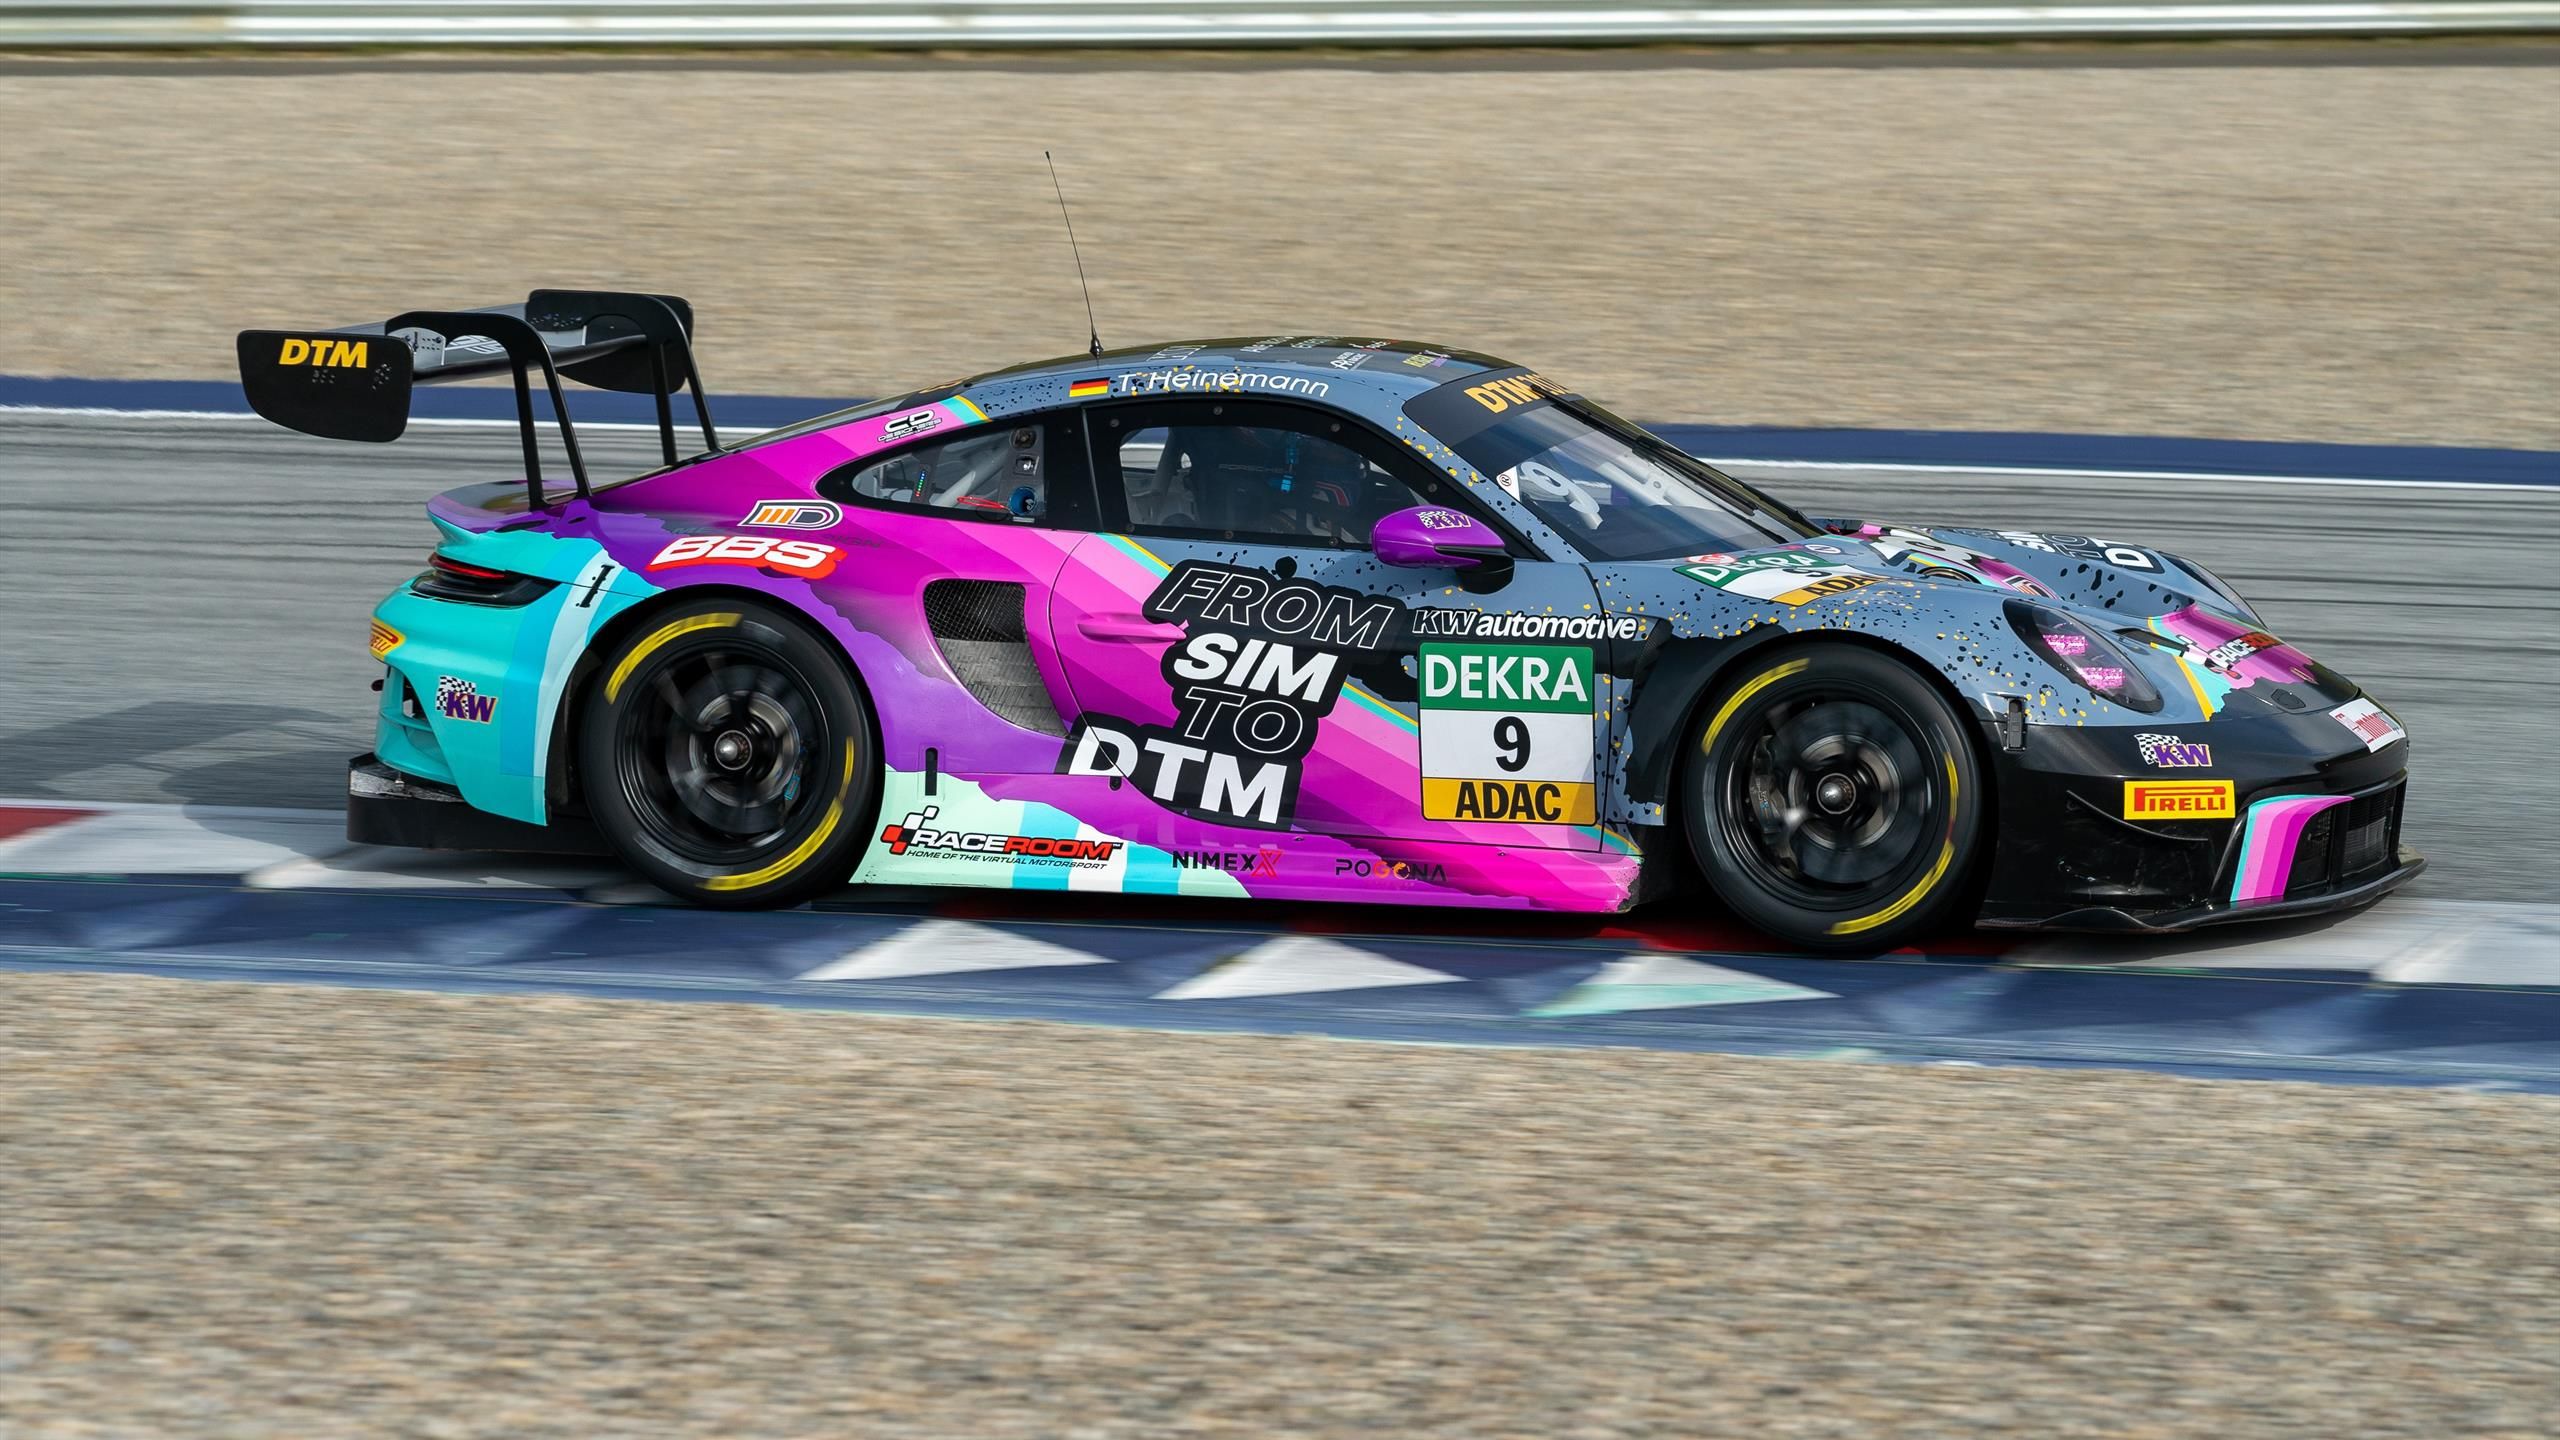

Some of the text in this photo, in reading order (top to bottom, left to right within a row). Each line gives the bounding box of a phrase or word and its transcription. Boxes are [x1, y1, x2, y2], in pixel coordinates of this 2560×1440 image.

[279, 338, 367, 369] DTM
[1117, 369, 1330, 398] T. Heinemann
[1431, 514, 1472, 530] KW
[649, 536, 838, 569] BBS
[1155, 567, 1395, 650] FROM
[1173, 632, 1339, 703] SIM
[1424, 653, 1589, 702] DEKRA
[445, 691, 497, 723] KW
[1184, 686, 1303, 754] TO
[1492, 715, 1532, 773] 9
[2154, 743, 2211, 767] KW
[1067, 725, 1288, 825] DTM
[1455, 781, 1562, 822] ADAC
[2133, 786, 2226, 812] PIRELLI
[906, 850, 940, 859] HOME
[982, 856, 1027, 865] VIRTUAL
[1028, 858, 1108, 870] MOTORSPORT
